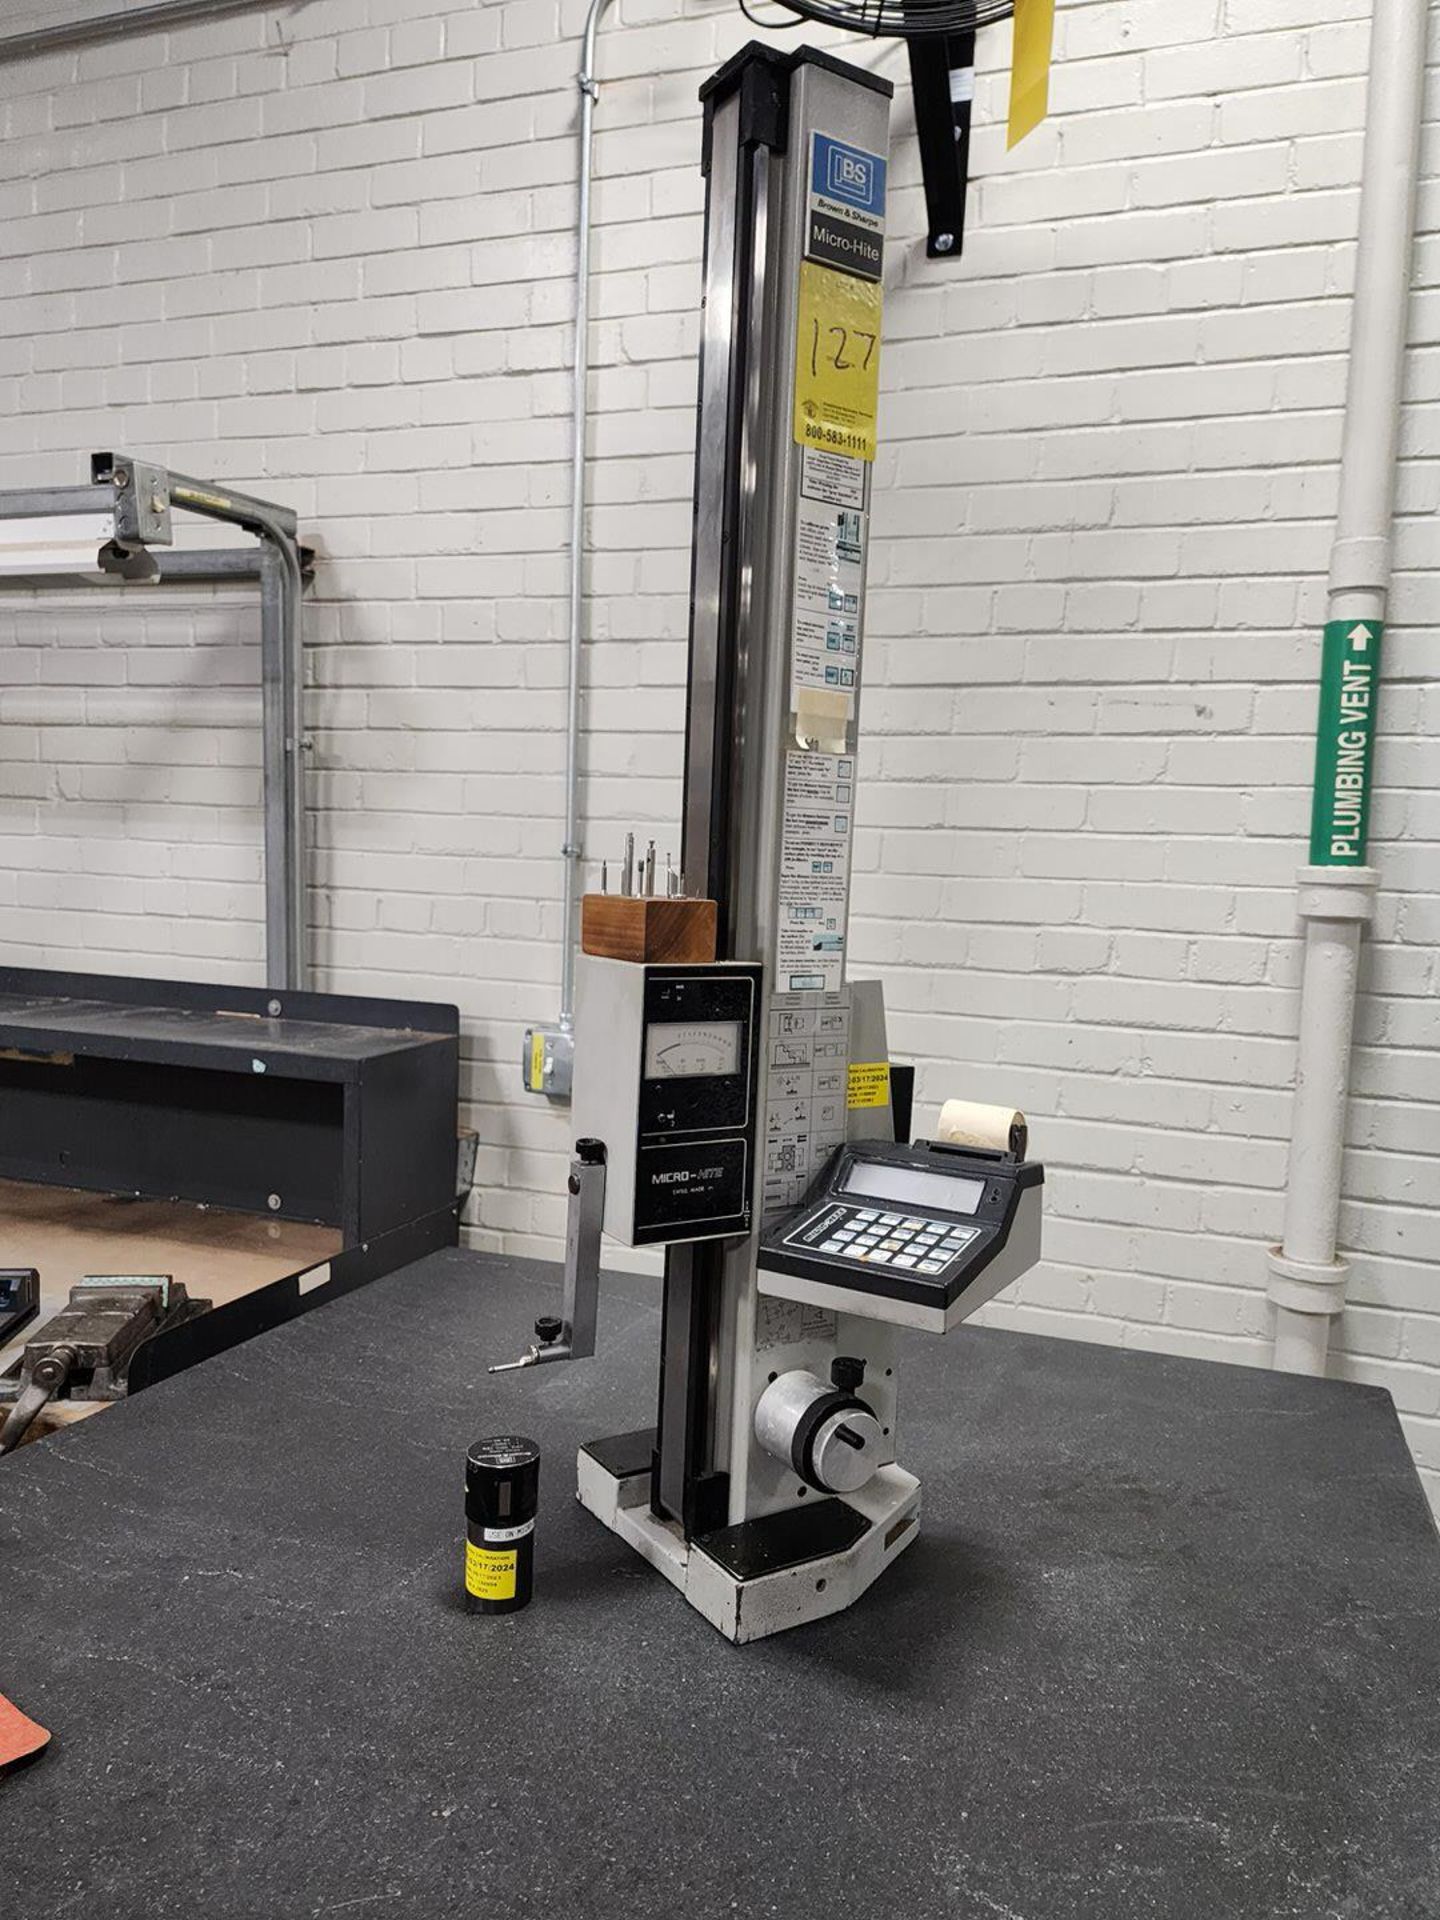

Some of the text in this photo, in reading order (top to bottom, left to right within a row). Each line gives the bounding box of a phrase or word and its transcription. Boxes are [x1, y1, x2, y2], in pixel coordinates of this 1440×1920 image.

[817, 197, 879, 228] Brown & Sharpe
[813, 225, 880, 261] Micro-Hite
[813, 317, 876, 378] 127
[805, 423, 868, 451] 800-583-1111
[1330, 659, 1373, 857] PLUMBING VENT
